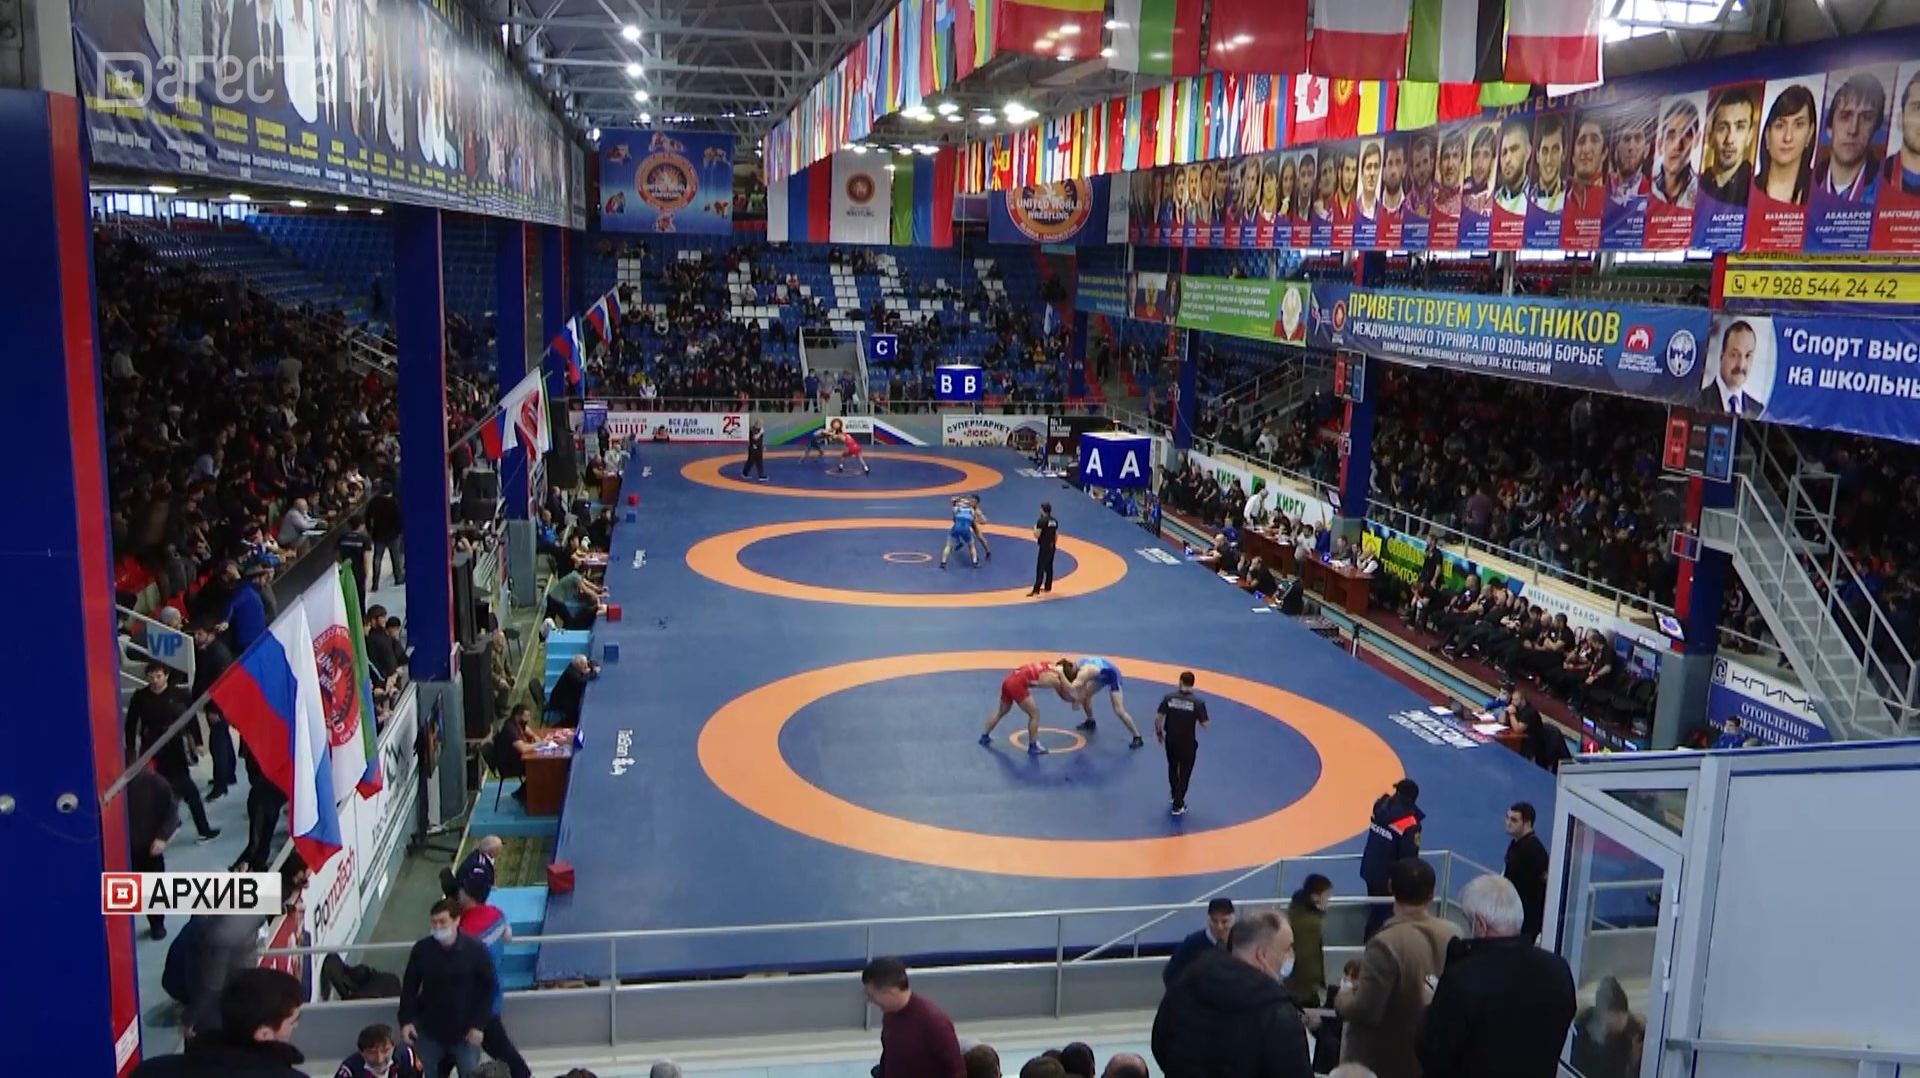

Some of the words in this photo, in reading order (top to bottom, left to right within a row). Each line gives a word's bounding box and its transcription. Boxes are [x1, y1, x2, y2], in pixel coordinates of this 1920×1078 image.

[1879, 210, 1920, 219] МАГОМЕД
[1751, 276, 1769, 294] +7
[1773, 276, 1802, 295] 928
[1807, 278, 1840, 296] 544
[1845, 278, 1868, 298] 24
[1874, 279, 1898, 298] 42
[1348, 292, 1471, 329] ПРИВЕТСТВУЕМ
[1476, 302, 1621, 344] УЧАСТНИКОВ
[1352, 320, 1434, 343] МЕЖДУНАРОДНОГО
[1436, 329, 1479, 350] ТУРНИРА
[1481, 335, 1495, 351] ПО
[1498, 336, 1551, 359] ВОЛЬНОЙ
[1555, 343, 1604, 366] БОРЬБЕ
[1868, 339, 1920, 364] выс
[1460, 351, 1487, 367] БОРЦОВ
[1511, 357, 1551, 375] СТОЛЕТИЙ
[1788, 366, 1814, 385] на
[668, 418, 681, 426] ВСЕ
[683, 418, 698, 427] ДЛЯ
[723, 416, 740, 433] 25
[947, 420, 1010, 433] СУПЕРМАРКЕТ
[1573, 606, 1600, 623] САЛОН
[149, 632, 183, 657] VIP
[1741, 702, 1810, 740] ОТОПЛЕНИЕ
